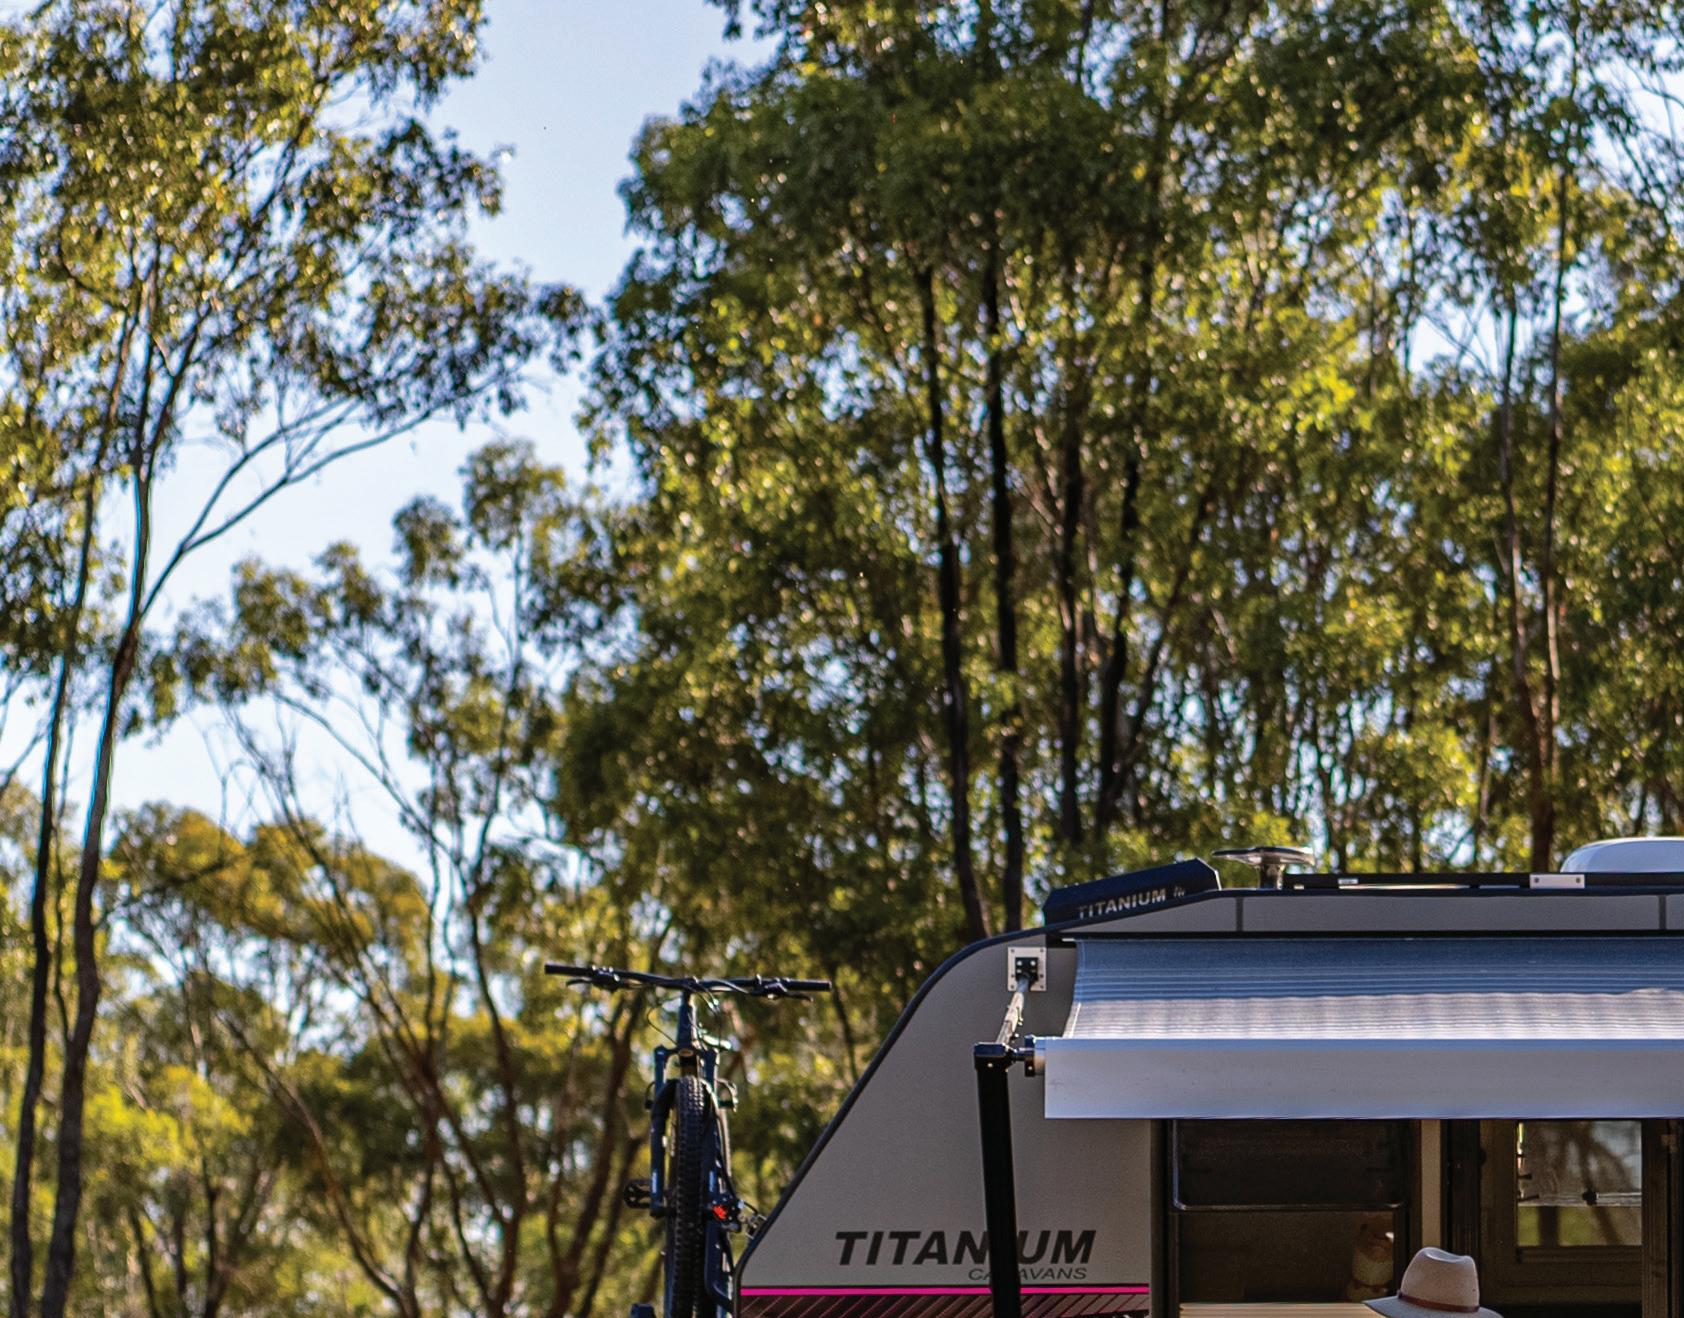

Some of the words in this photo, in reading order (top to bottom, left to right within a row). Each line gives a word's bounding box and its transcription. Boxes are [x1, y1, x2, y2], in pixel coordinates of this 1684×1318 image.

[1078, 887, 1167, 920] TITANIUM
[835, 1230, 1096, 1266] TITANUM
[968, 1267, 1088, 1281] CAVANS
